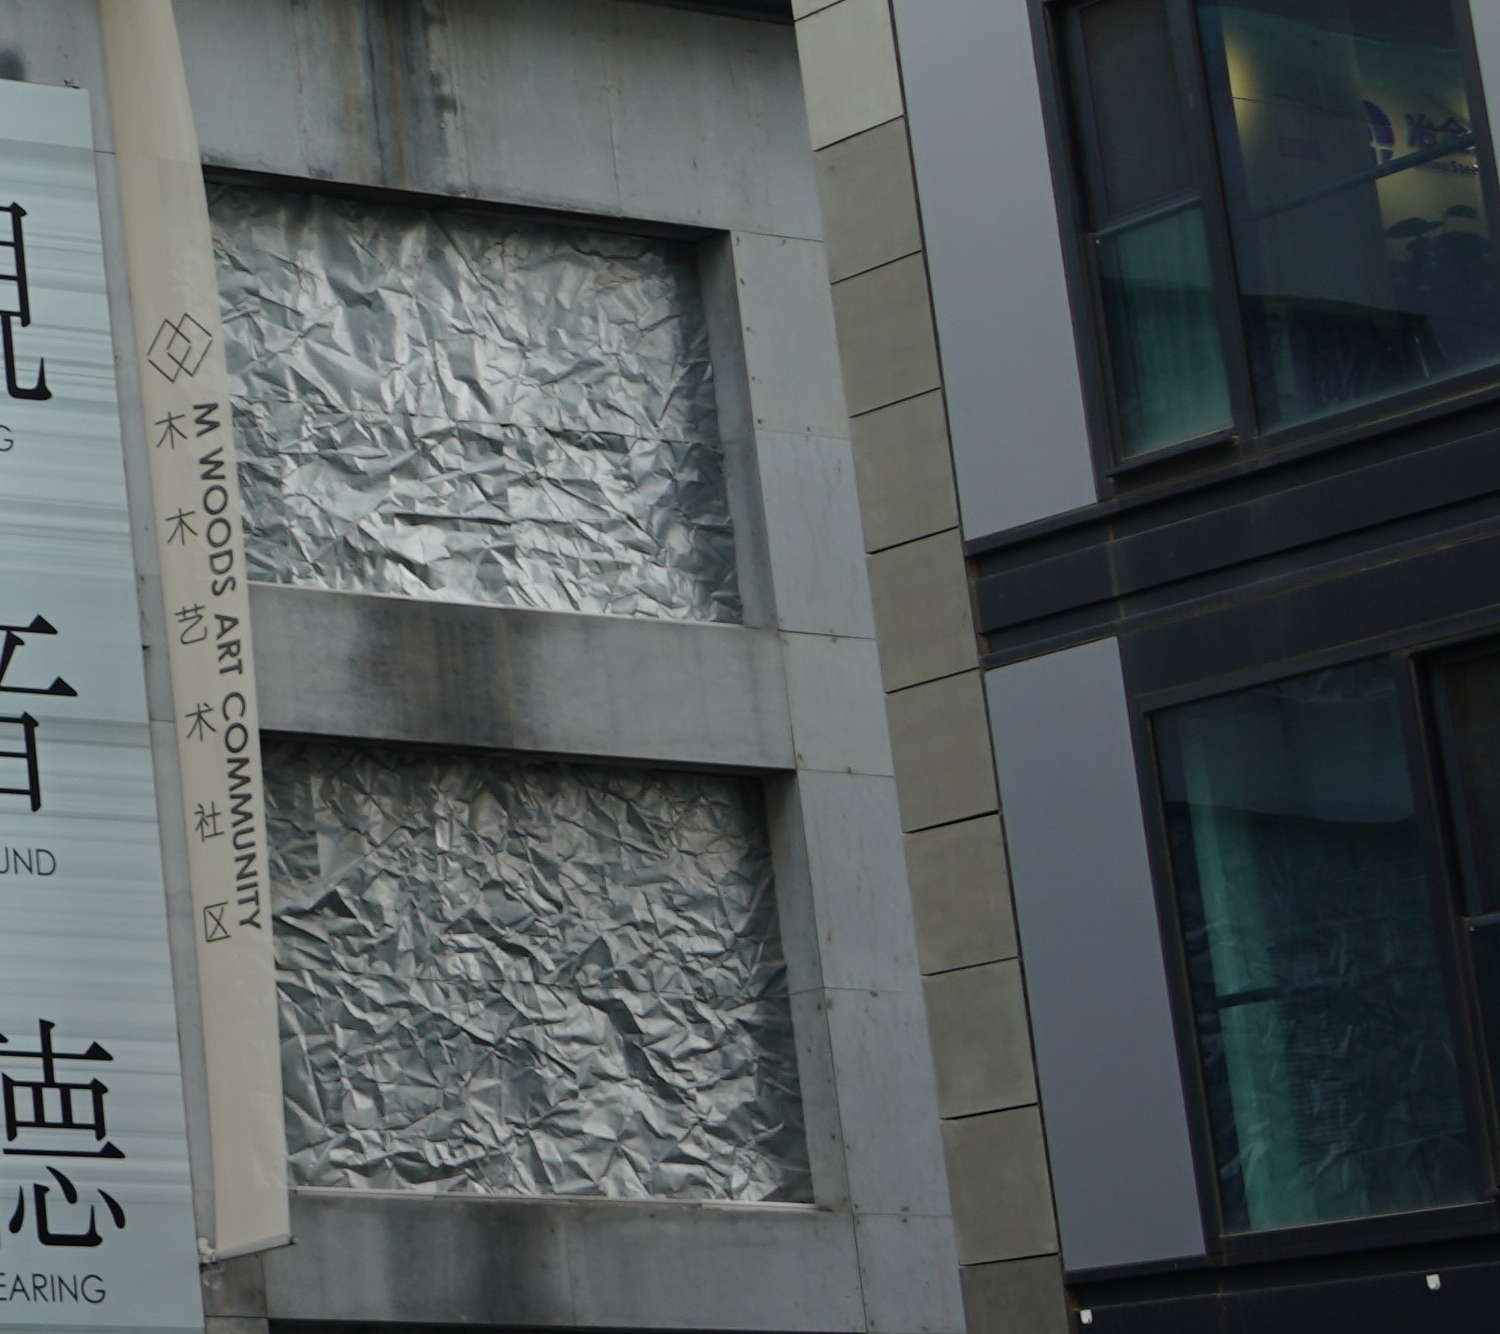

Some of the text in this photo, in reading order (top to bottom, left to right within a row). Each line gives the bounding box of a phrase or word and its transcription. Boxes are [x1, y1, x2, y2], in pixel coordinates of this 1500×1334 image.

[154, 411, 231, 943] 木木艺术社区
[193, 401, 262, 930] M WOODS ART COMMUNITY
